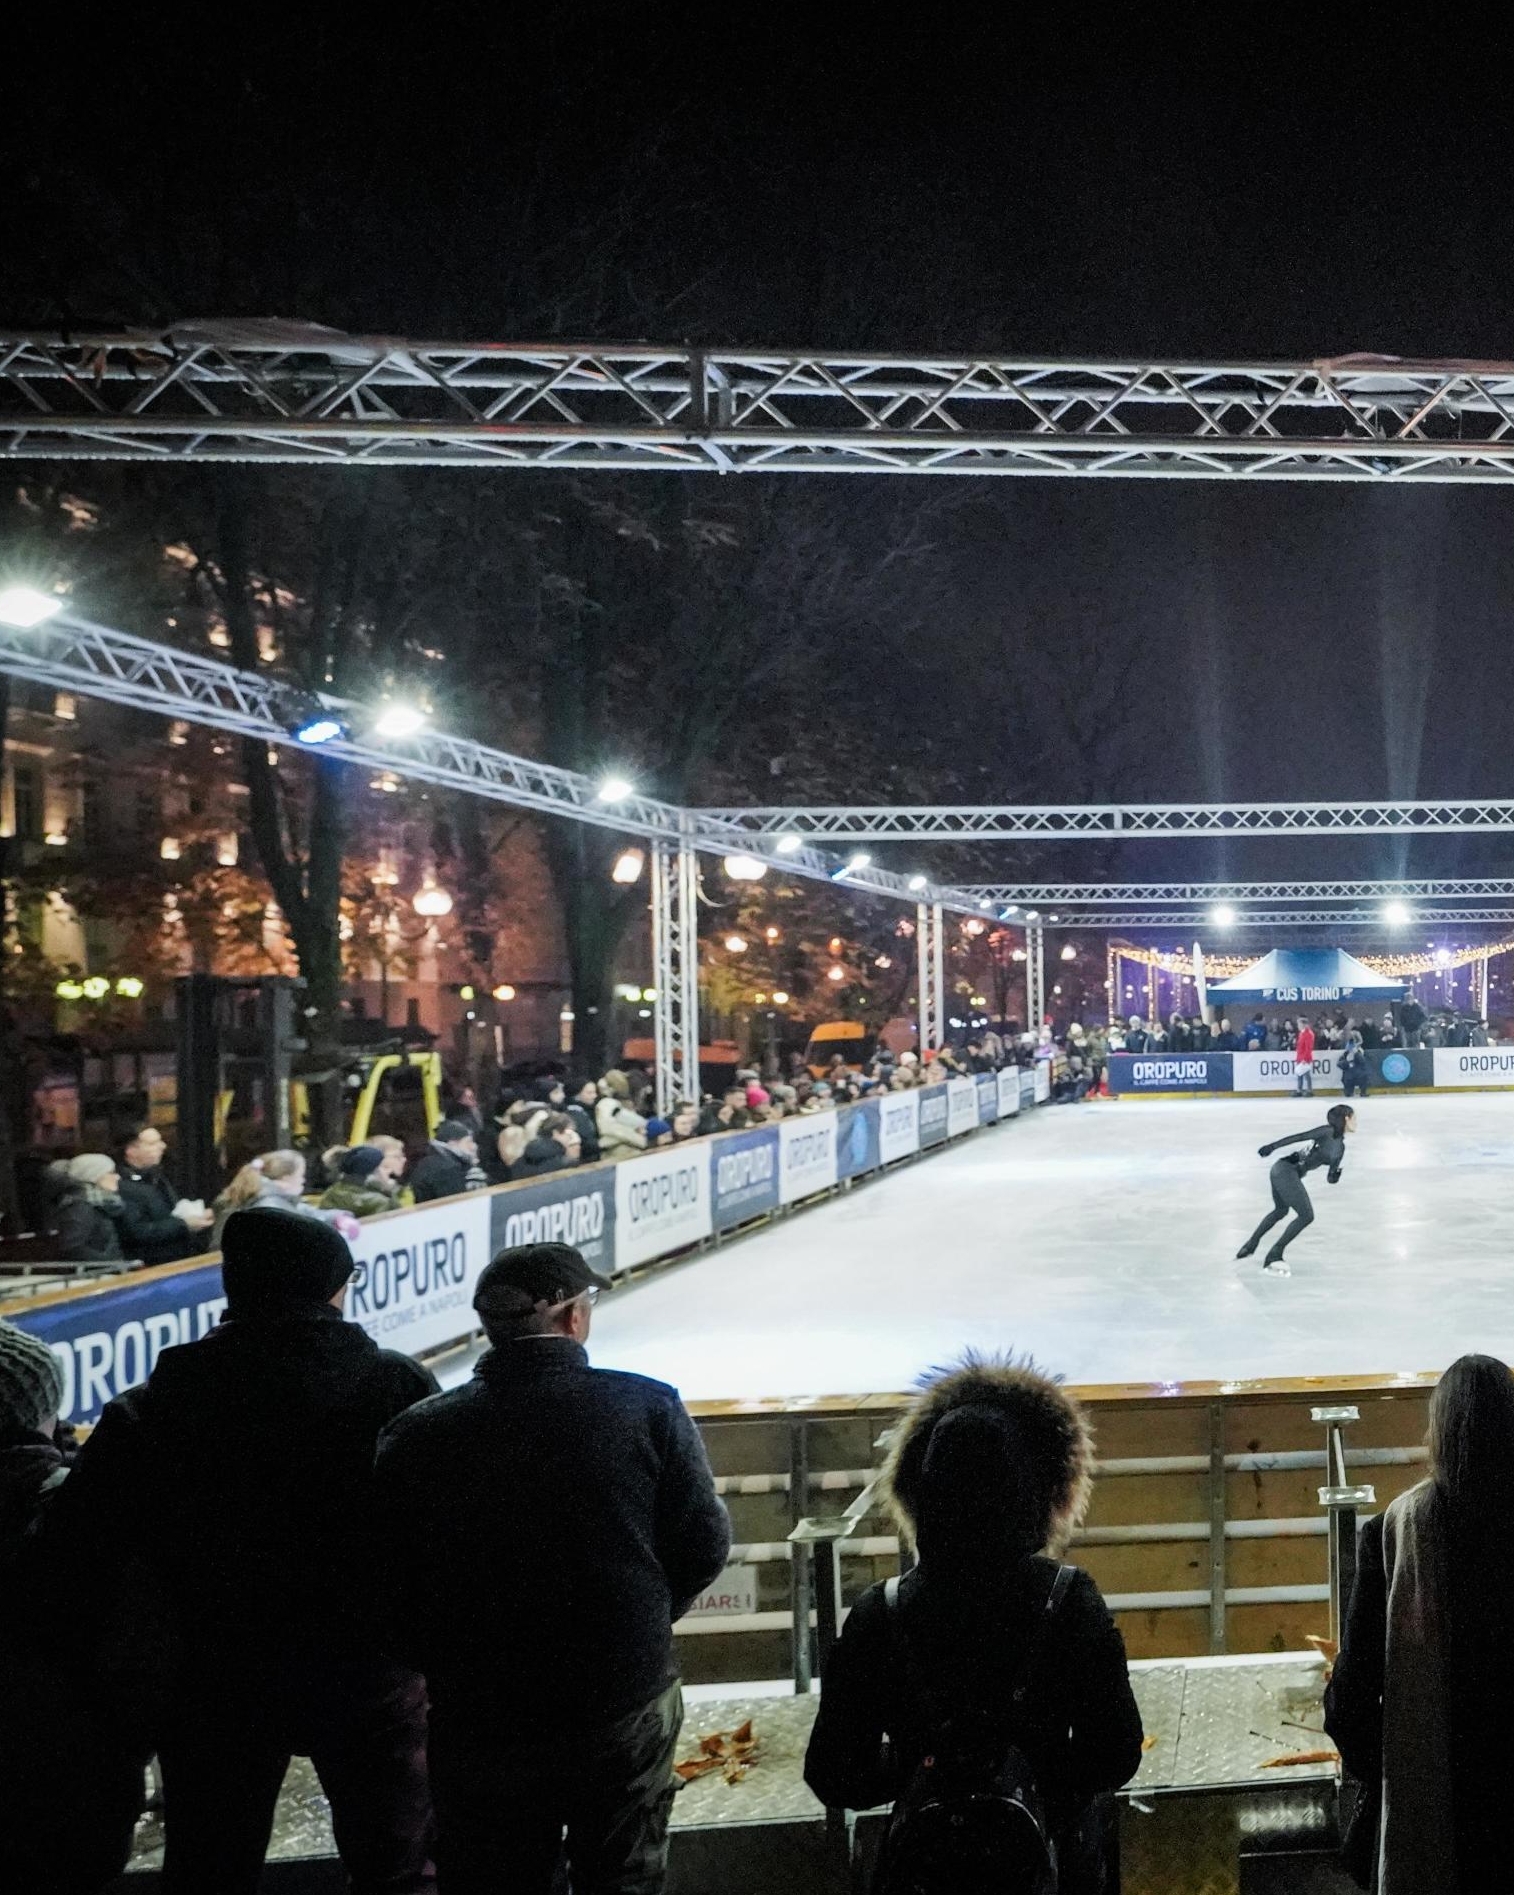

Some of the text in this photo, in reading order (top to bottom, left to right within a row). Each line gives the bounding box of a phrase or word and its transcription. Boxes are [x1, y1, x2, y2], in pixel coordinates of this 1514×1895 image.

[1276, 986, 1340, 1001] CUS TORINO
[1133, 1061, 1207, 1079] OROPURO
[1260, 1059, 1331, 1076] ORORO
[506, 1192, 604, 1248] OROPURO
[629, 1166, 699, 1223] OROPURO
[352, 1231, 466, 1317] ROPURO
[49, 1297, 228, 1421] OROP
